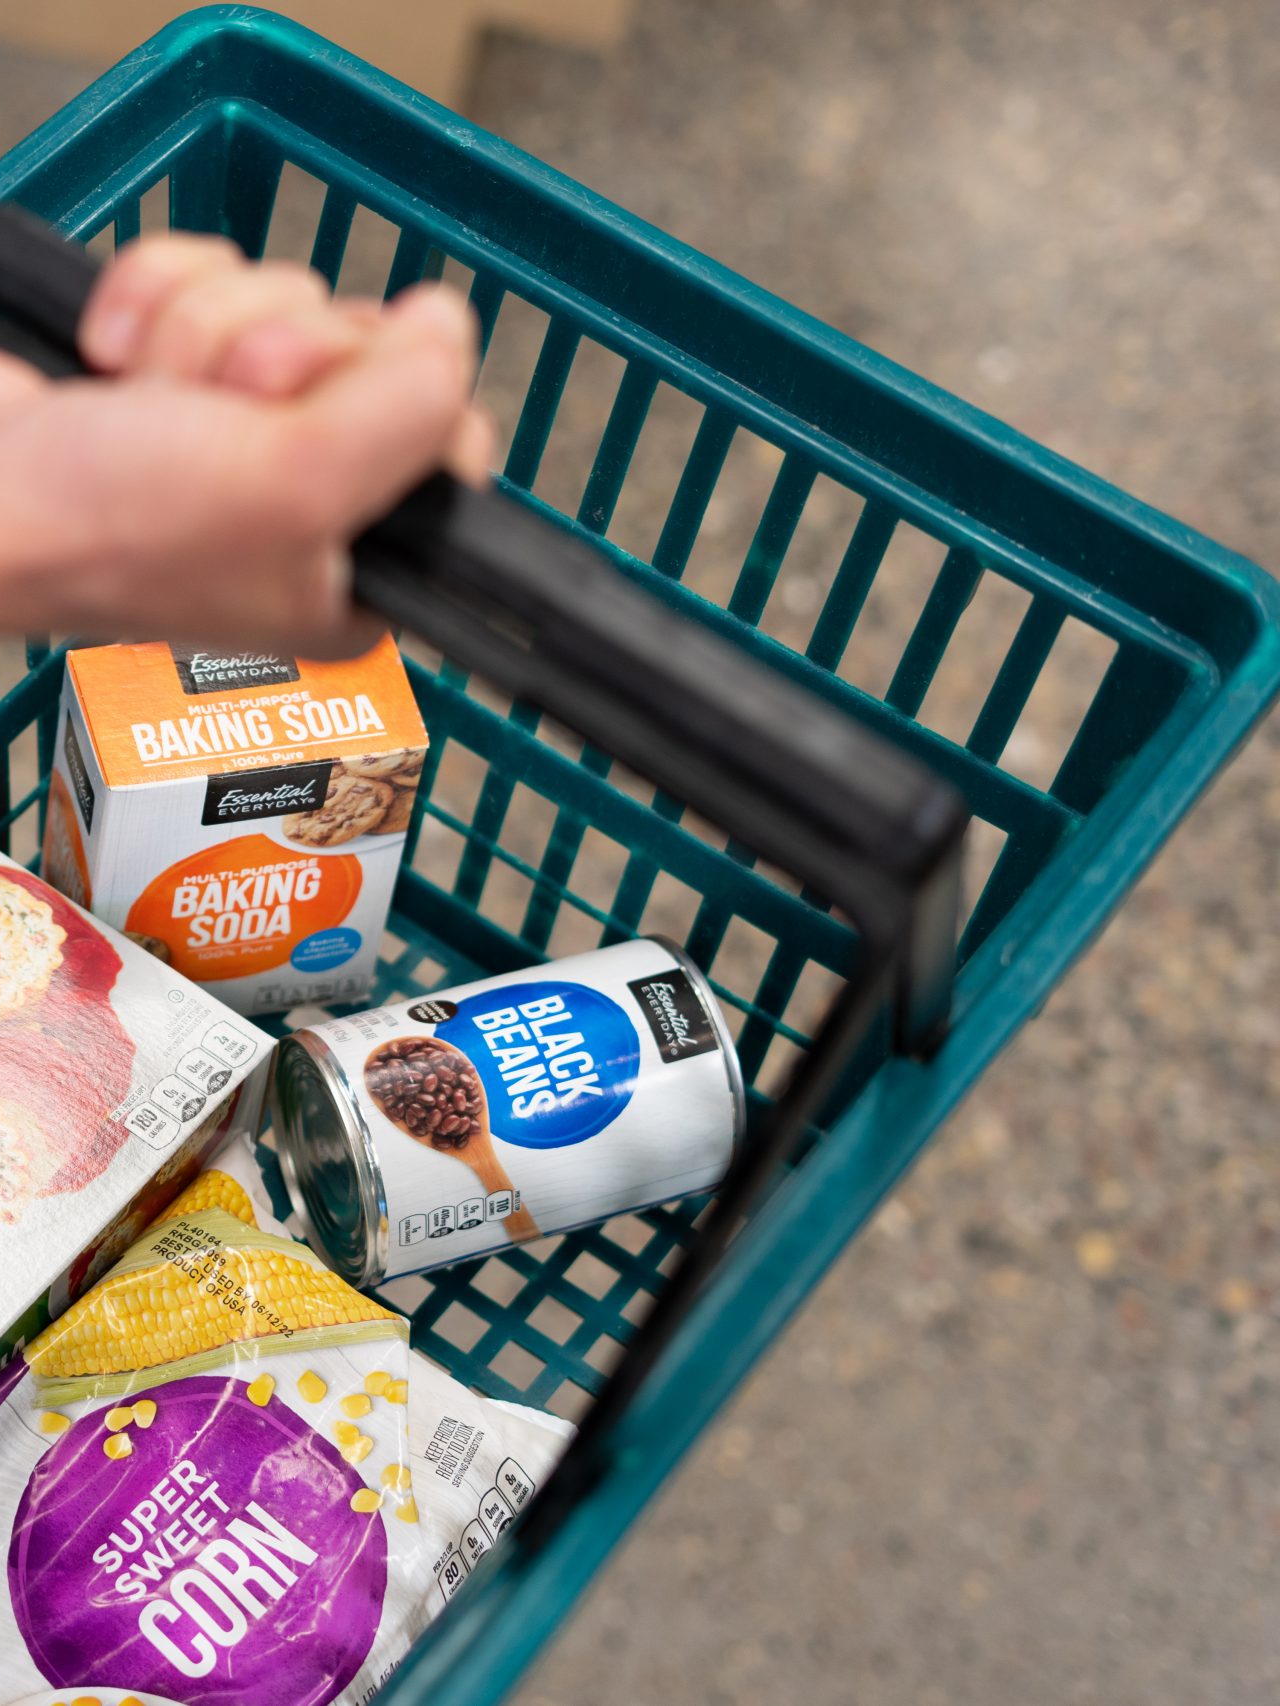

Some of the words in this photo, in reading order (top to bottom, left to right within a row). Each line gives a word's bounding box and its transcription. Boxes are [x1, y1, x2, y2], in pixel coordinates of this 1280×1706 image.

[190, 651, 278, 674] Essential
[195, 664, 280, 683] EVERYDAY
[188, 691, 311, 716] MULTI-PURPOSE
[130, 708, 274, 761] BAKING
[279, 694, 385, 742] SODA
[231, 755, 268, 768] 100%
[272, 751, 304, 763] Pure
[218, 779, 316, 808] Essential
[218, 797, 308, 816] EVERYDAY
[183, 858, 319, 885] MULTI-PURPOSE
[172, 867, 322, 918] BAKING
[187, 905, 291, 948] SODA
[240, 945, 274, 956] Pure
[641, 986, 677, 1048] EVERYDAY
[650, 982, 697, 1047] Essential
[472, 1006, 558, 1119] BEANS
[518, 995, 603, 1107] BLACK
[131, 1108, 157, 1131] 180
[496, 1198, 509, 1213] 110
[177, 1221, 222, 1247] PL40164
[168, 1229, 227, 1267] RKBGA099
[150, 1244, 207, 1284] PRODUCT
[205, 1283, 224, 1297] OF
[222, 1295, 247, 1316] USA
[159, 1237, 192, 1257] BEST
[190, 1252, 204, 1263] IF
[203, 1263, 234, 1290] USED
[234, 1286, 251, 1301] BY
[251, 1300, 294, 1339] 06/12/22
[424, 1440, 444, 1464] KEEP
[434, 1416, 458, 1445] FROZEN
[447, 1440, 465, 1455] TO
[453, 1422, 475, 1446] COOK
[435, 1450, 460, 1481] READY
[452, 1462, 469, 1488] SERVING
[463, 1430, 485, 1465] SUGGESTION
[505, 1473, 517, 1486] 8g
[512, 1481, 523, 1496] TOTAL
[92, 1459, 210, 1574] SUPER
[484, 1503, 500, 1520] 0mg
[115, 1481, 232, 1601] SWEET
[467, 1536, 478, 1549] 0g
[432, 1561, 442, 1574] PER
[445, 1561, 459, 1585] 80
[138, 1502, 319, 1678] CORN
